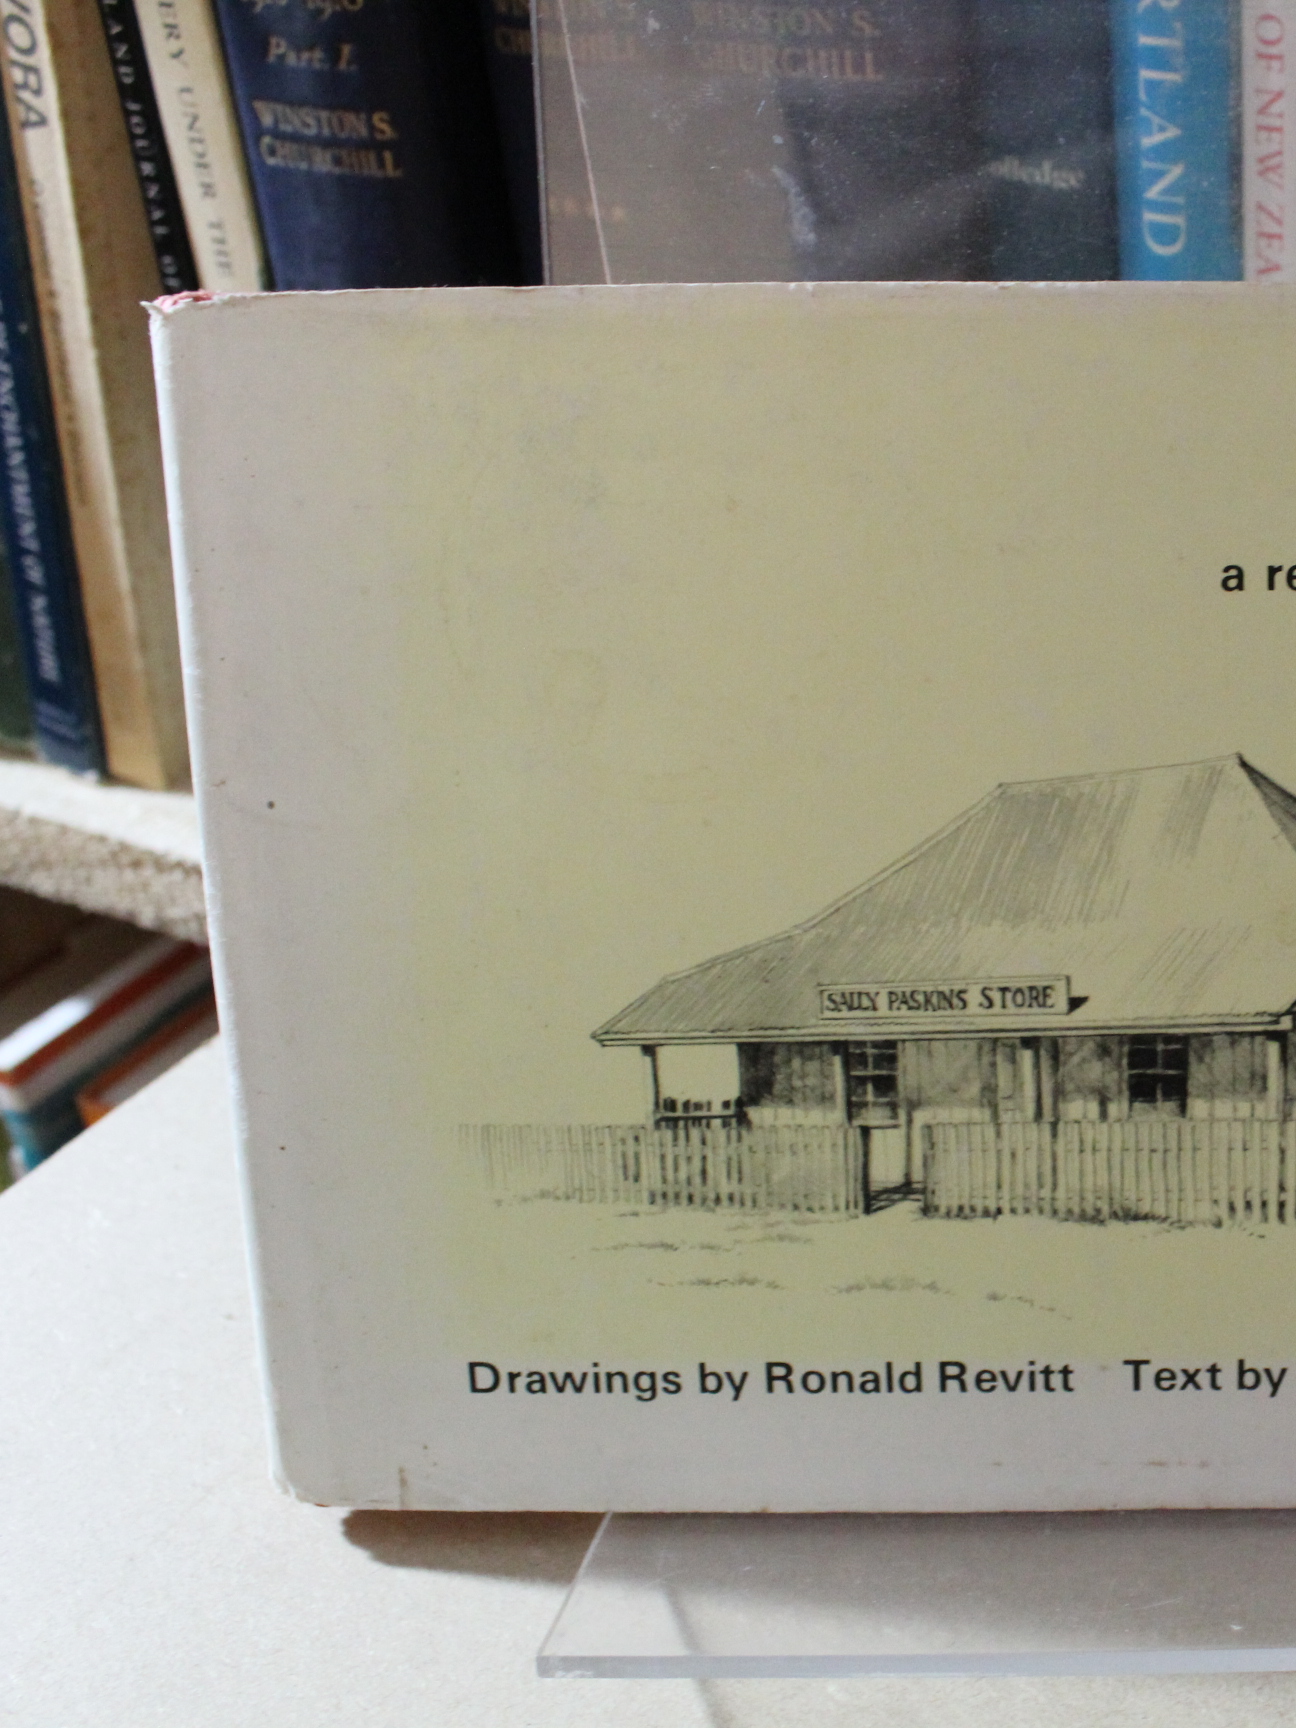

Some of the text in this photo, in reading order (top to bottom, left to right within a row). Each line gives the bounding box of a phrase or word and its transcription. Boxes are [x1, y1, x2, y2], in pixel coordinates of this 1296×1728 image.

[1255, 13, 1285, 75] OF
[252, 99, 369, 139] WINSTON
[1255, 87, 1285, 192] NEW
[178, 86, 218, 199] UNDER
[1221, 564, 1245, 592] a
[825, 985, 1055, 1013] SALLY PASKINS STORE
[468, 1361, 682, 1402] Drawings
[699, 1362, 748, 1401] by
[765, 1361, 922, 1394] Ronald
[939, 1360, 1074, 1393] Revitt
[1123, 1359, 1222, 1392] Text
[1237, 1358, 1288, 1398] by
